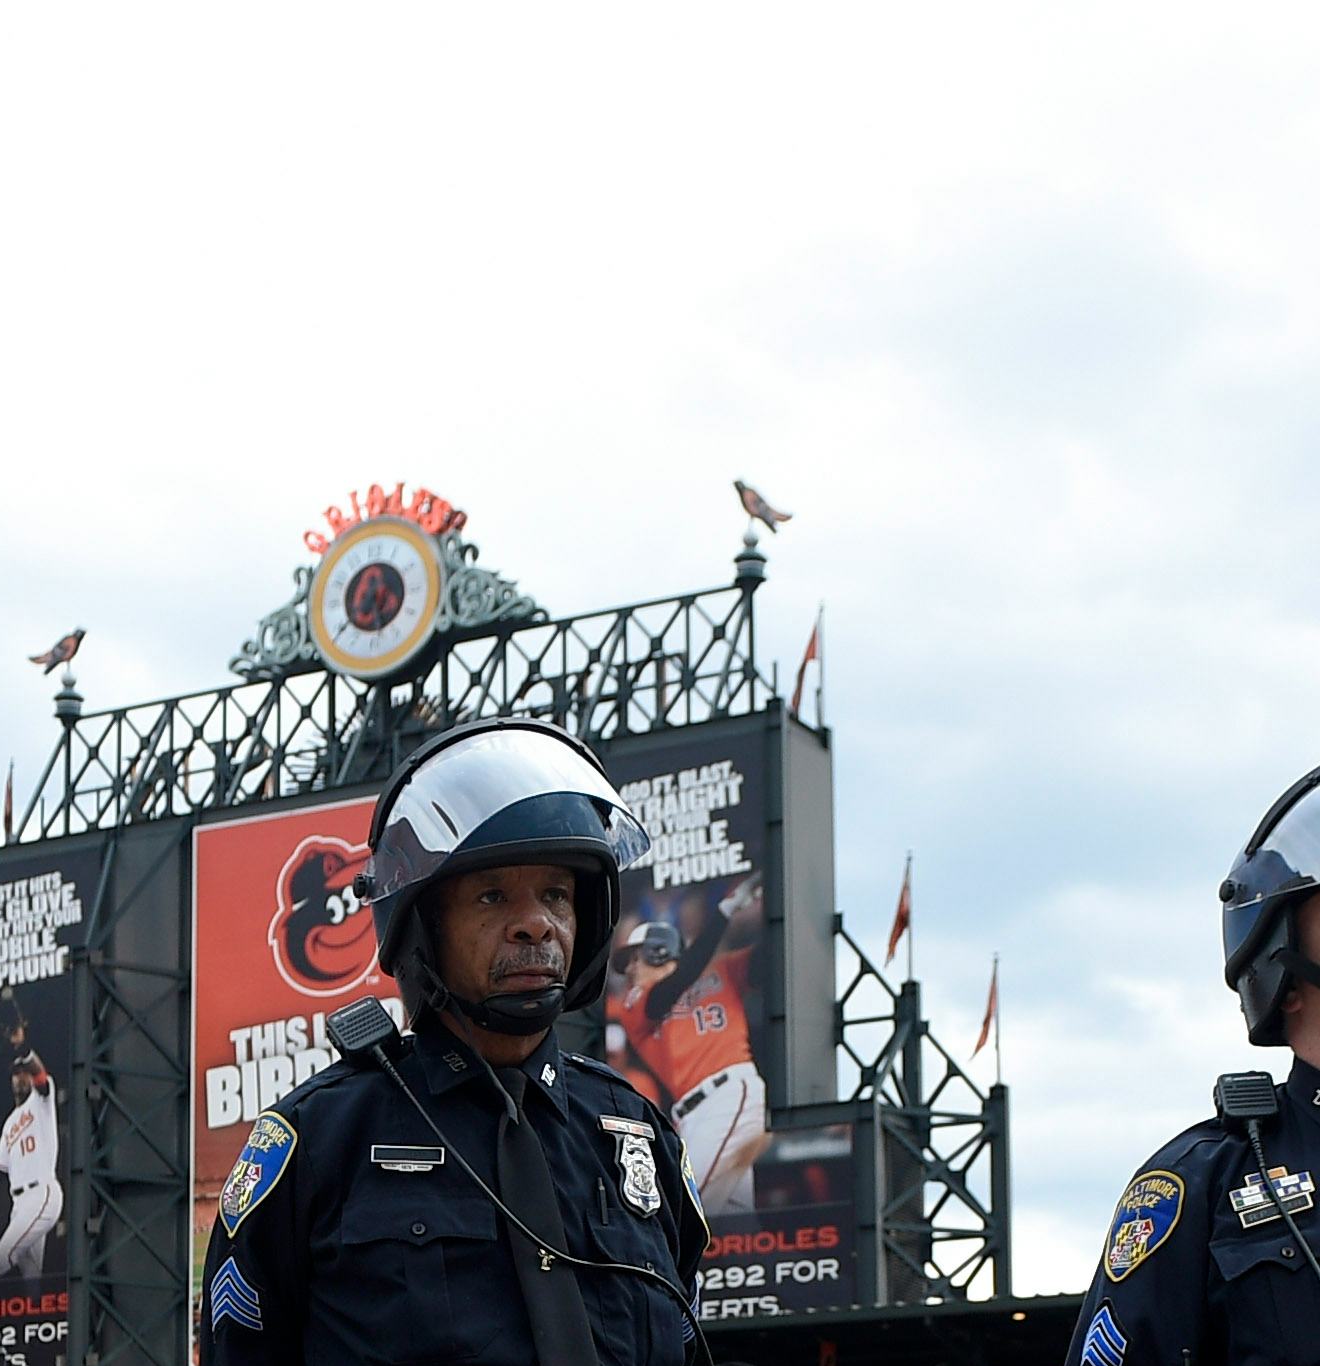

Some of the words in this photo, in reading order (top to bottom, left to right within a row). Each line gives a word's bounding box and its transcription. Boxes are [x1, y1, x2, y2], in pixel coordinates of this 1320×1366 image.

[630, 774, 744, 823] TRAIGHT
[664, 809, 711, 834] YOUR
[652, 842, 752, 890] PHONE.
[5, 882, 76, 921] GLOVE
[14, 879, 28, 900] IT
[29, 871, 62, 896] HITS
[12, 913, 44, 936] HITS
[45, 899, 82, 928] YOUR
[693, 1002, 728, 1036] 13
[229, 1015, 309, 1066] THIS
[20, 1135, 37, 1157] 10
[701, 1225, 841, 1258] ORIOLES
[695, 1264, 766, 1290] 292
[775, 1258, 840, 1284] FOR
[697, 1295, 784, 1322] ERTS.
